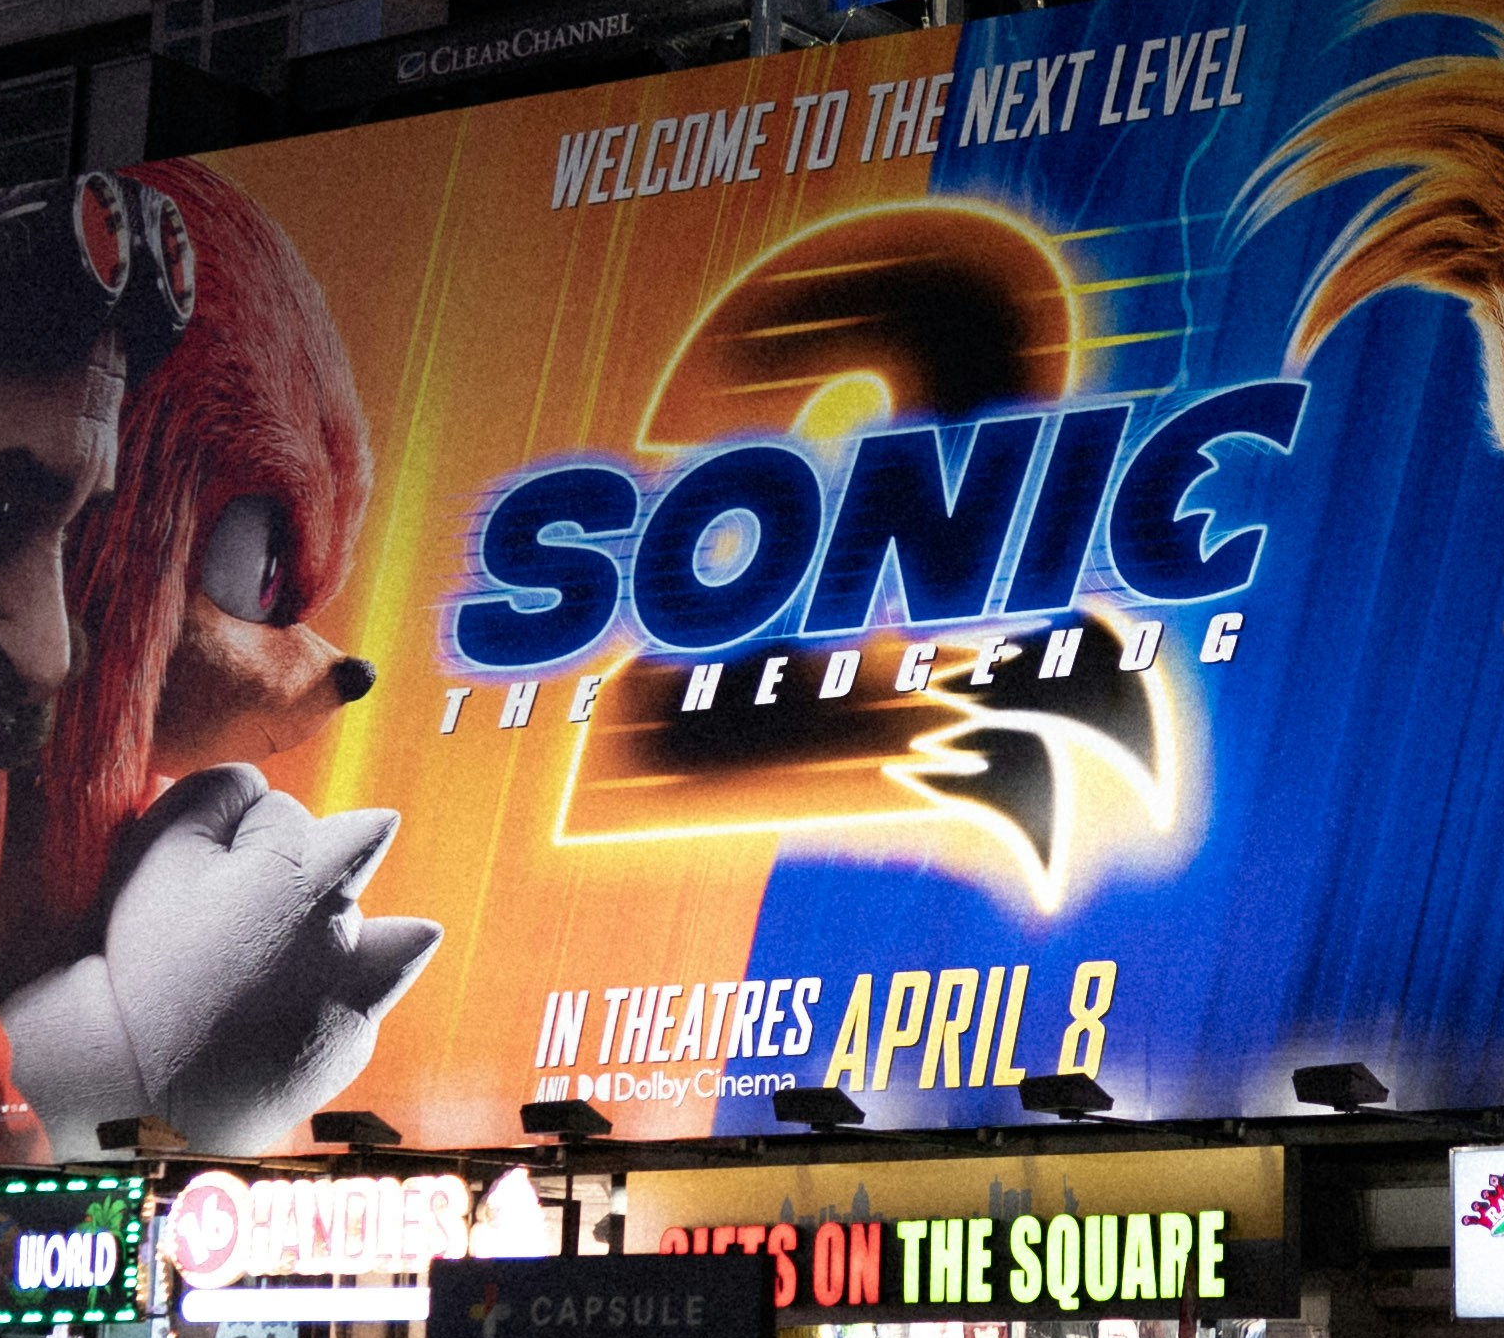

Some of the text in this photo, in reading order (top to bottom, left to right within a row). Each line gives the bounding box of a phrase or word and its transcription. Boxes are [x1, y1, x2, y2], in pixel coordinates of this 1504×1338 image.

[550, 24, 1246, 210] WELCOME TO THE NEXT LEVEL
[454, 376, 1311, 669] SONIC
[439, 611, 1245, 734] THE HEDGEHOG
[535, 960, 1117, 1091] IN THEATRES APRIL 8
[613, 1070, 689, 1107] Dolby
[693, 1069, 796, 1099] Cinema
[17, 1230, 118, 1289] WORLD
[248, 1183, 456, 1265] HANDLES
[812, 1222, 881, 1307] ON
[896, 1217, 993, 1304] THE
[1008, 1209, 1225, 1311] SQUARE
[530, 1294, 704, 1327] CAPSULE
